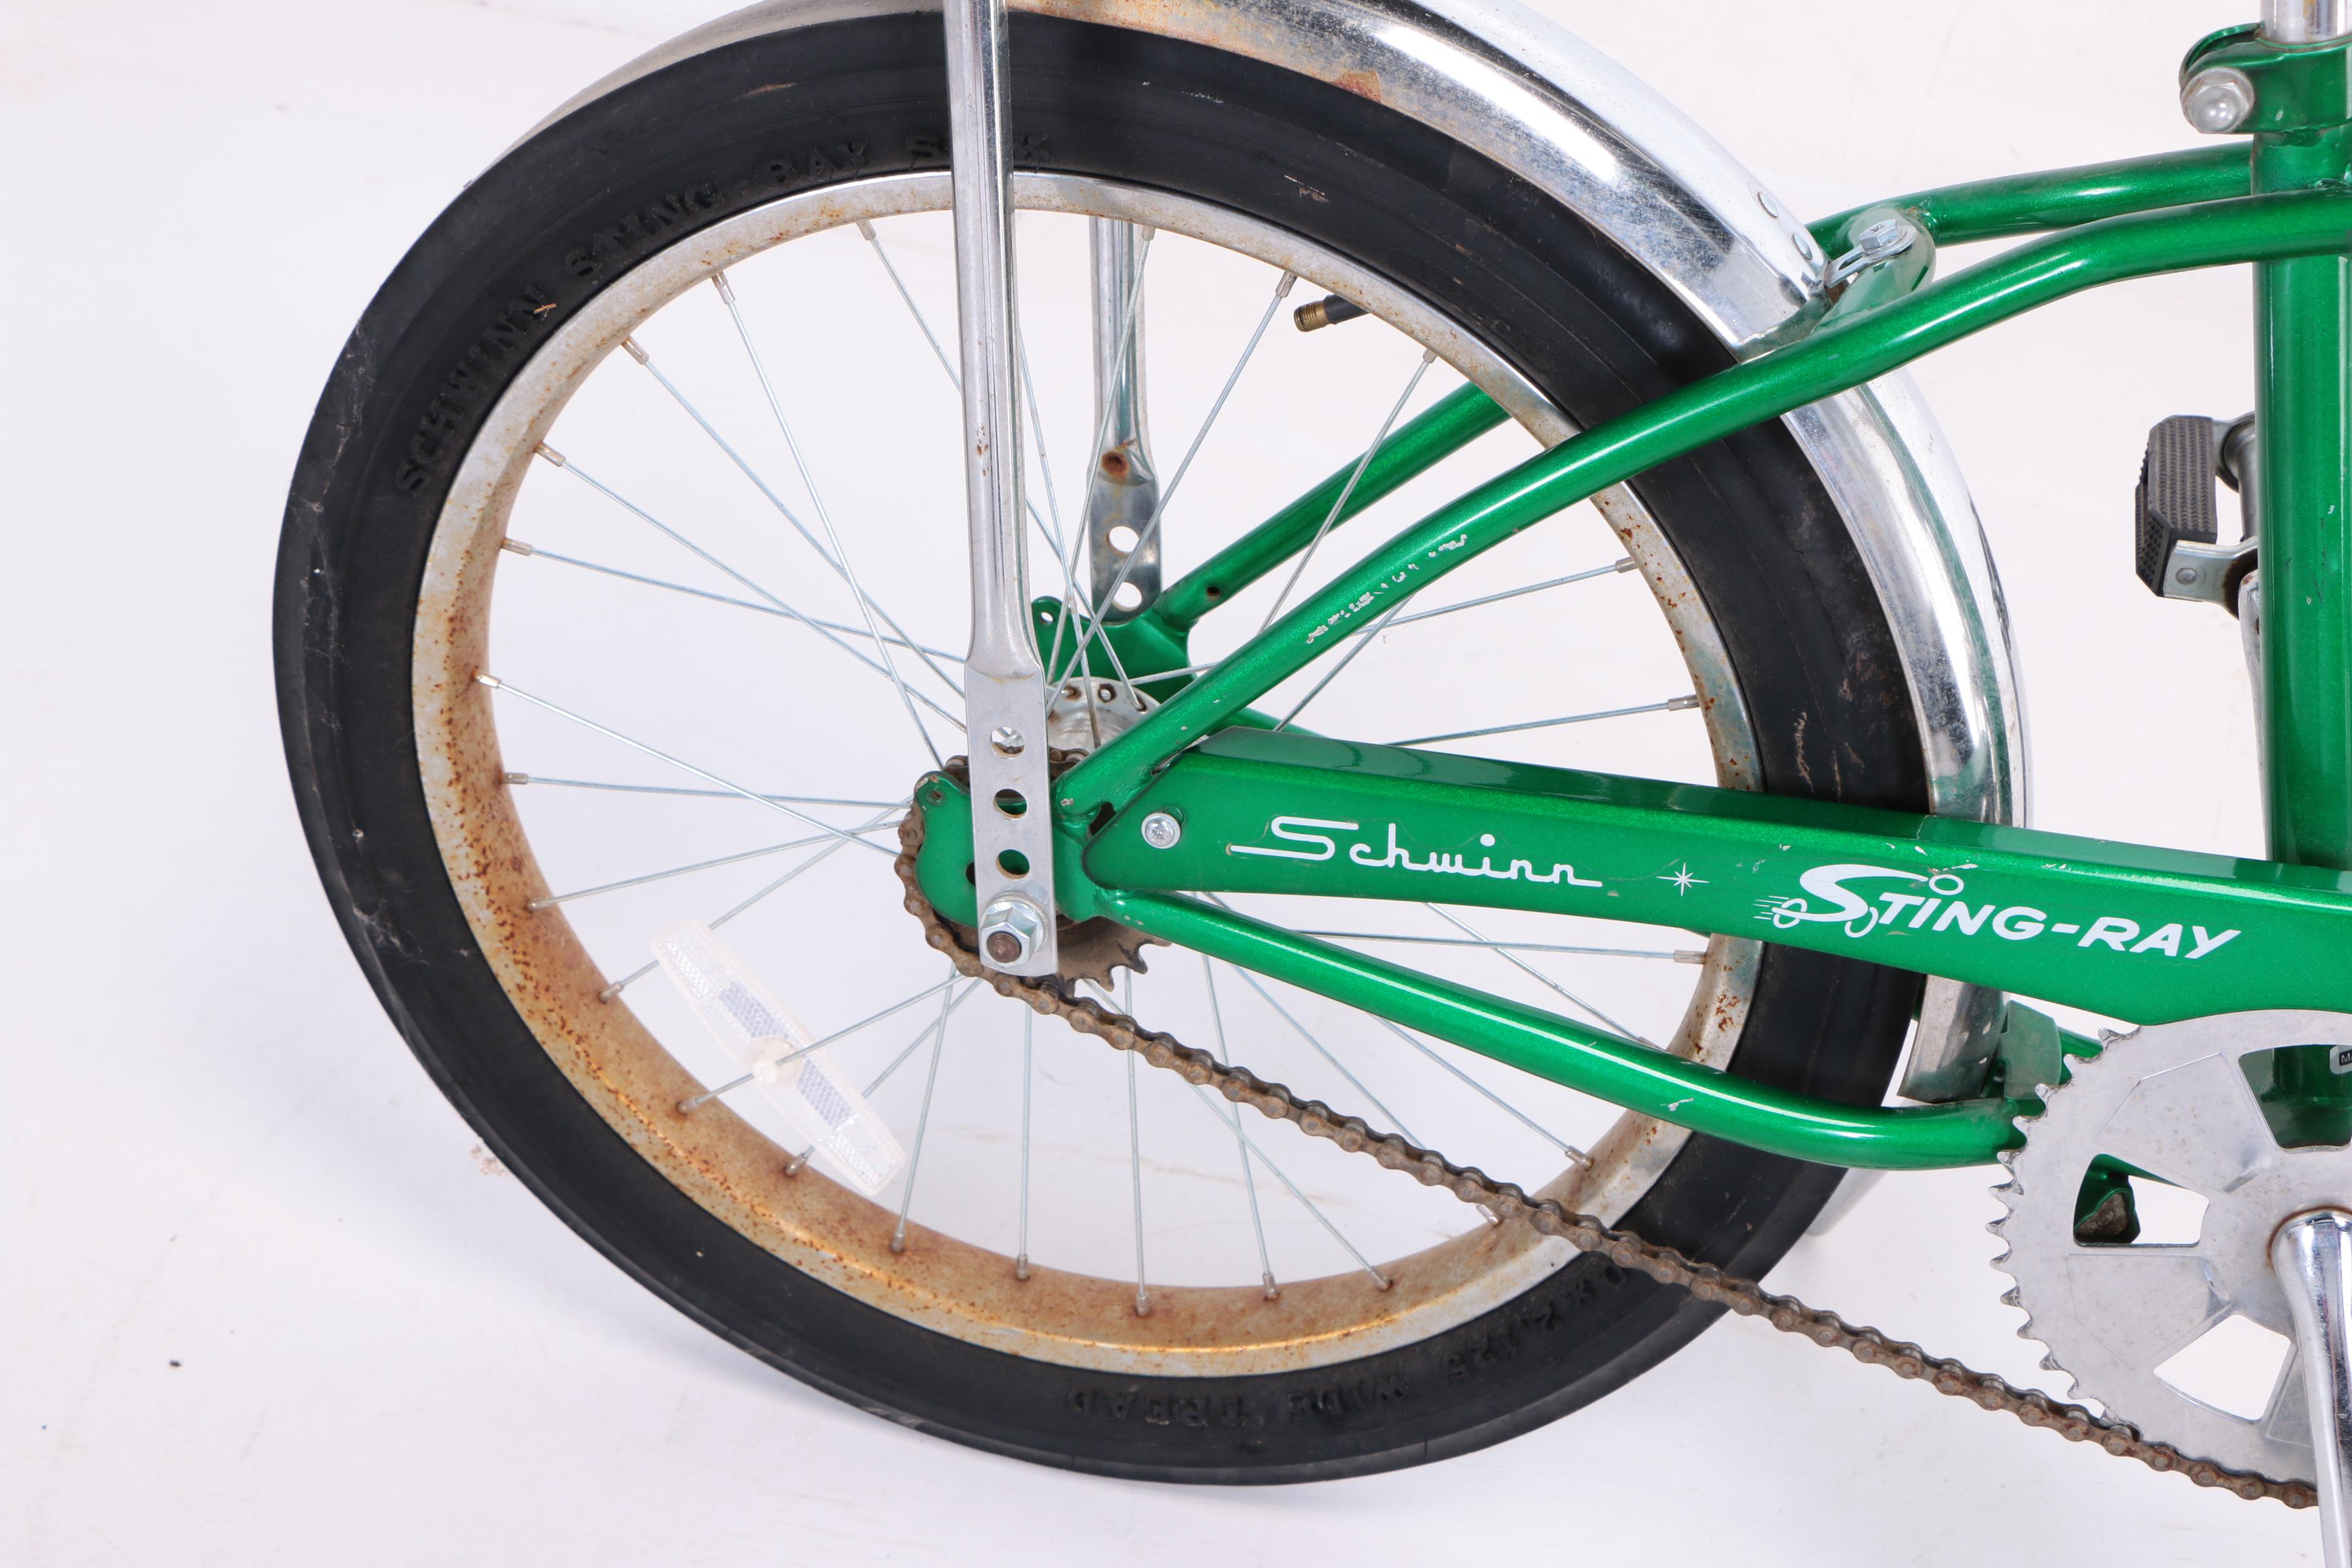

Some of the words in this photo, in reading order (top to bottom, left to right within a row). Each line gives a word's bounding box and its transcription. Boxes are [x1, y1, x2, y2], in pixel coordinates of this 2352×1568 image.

[396, 284, 556, 499] SCHWINN
[1230, 816, 1603, 888] Schwinn
[1771, 863, 2242, 959] STING-RAY
[1067, 1385, 1248, 1427] TREAD
